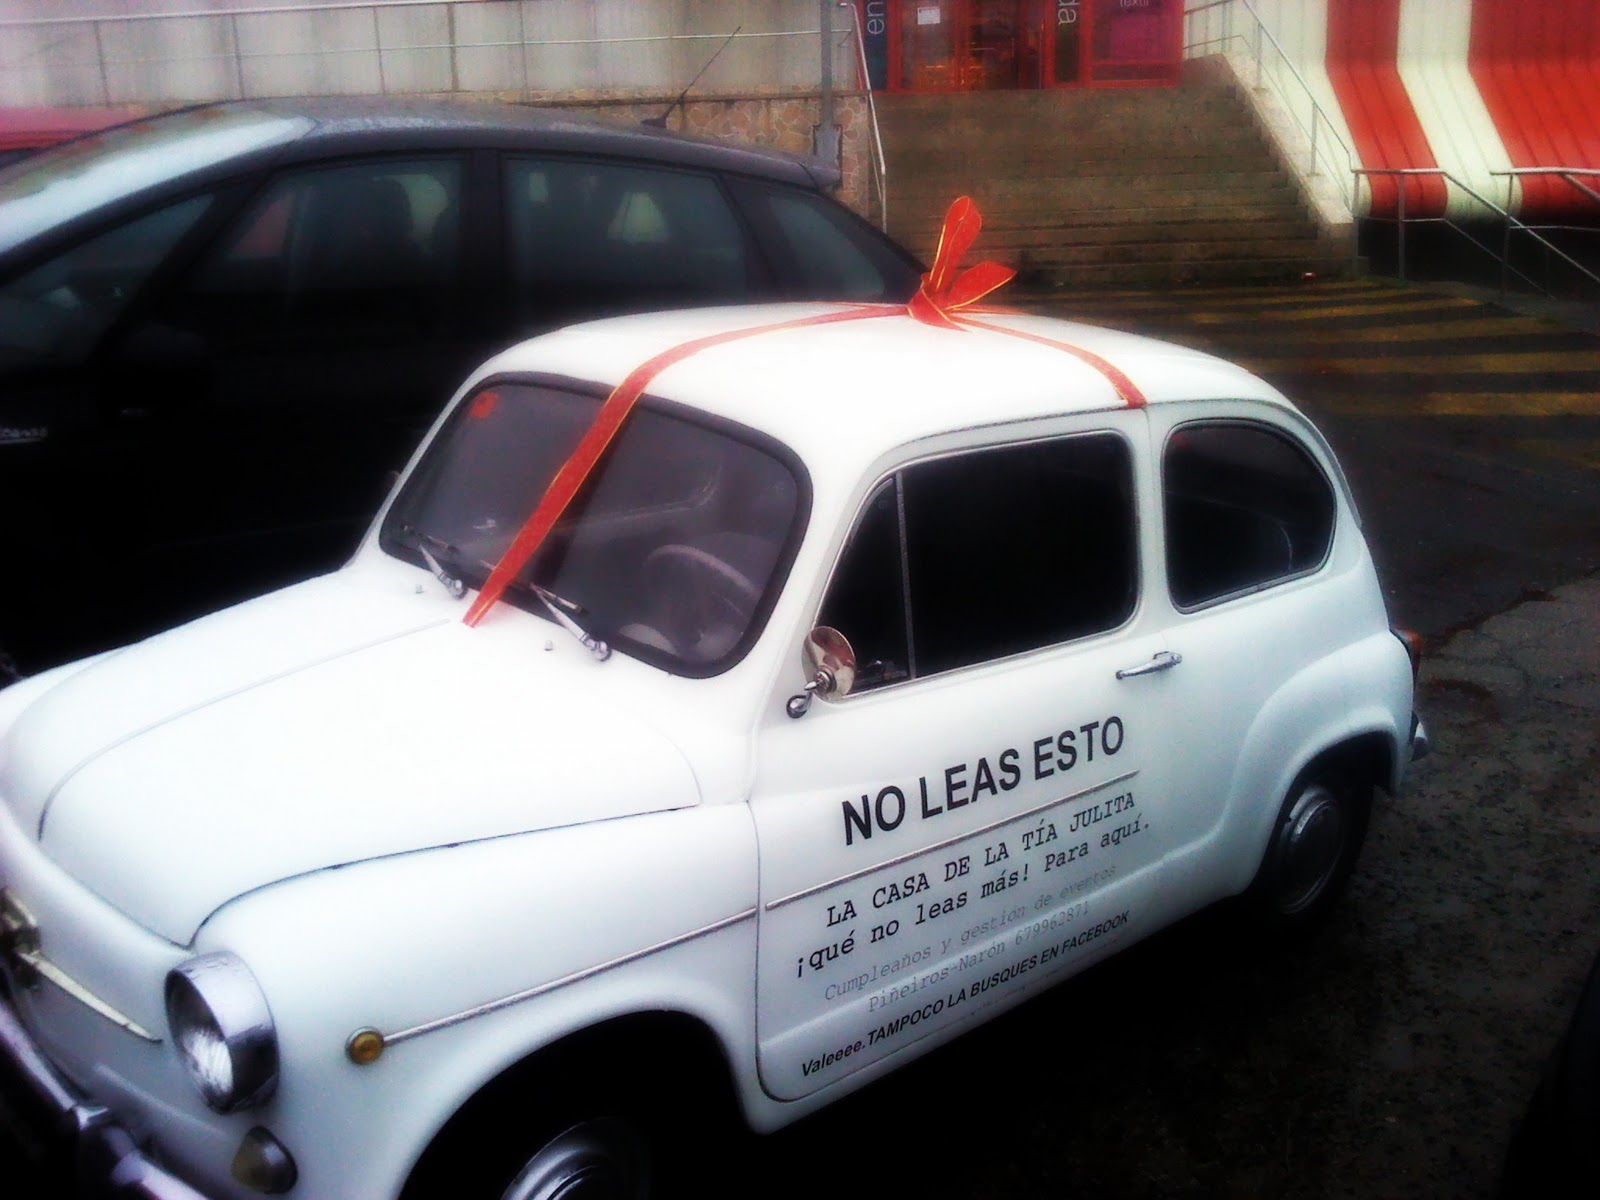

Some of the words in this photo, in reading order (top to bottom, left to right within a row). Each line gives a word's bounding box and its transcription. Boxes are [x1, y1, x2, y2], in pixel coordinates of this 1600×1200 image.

[842, 785, 906, 846] NO
[919, 748, 1021, 820] LEAS
[1033, 715, 1124, 781] ESTO
[796, 929, 856, 978] ¡qué
[870, 920, 900, 944] no
[915, 890, 969, 926] leas
[980, 864, 1030, 900] más!
[1044, 843, 1090, 874] Para
[1100, 813, 1150, 849] aquí.
[826, 899, 857, 928] LA
[872, 872, 930, 909] CASA
[944, 855, 971, 883] DE
[984, 840, 1010, 867] LA
[1022, 817, 1058, 852] TÍA
[1069, 791, 1136, 833] JULITA
[824, 948, 931, 1002] Cumpleaños
[938, 937, 953, 955] y
[960, 904, 1027, 946] gestión
[1034, 893, 1053, 911] de
[1060, 866, 1117, 899] eventos
[947, 987, 967, 1010] LA
[970, 954, 1038, 999] BUSQUES
[1040, 942, 1060, 964] EN
[1061, 909, 1131, 955] FACEBOOK
